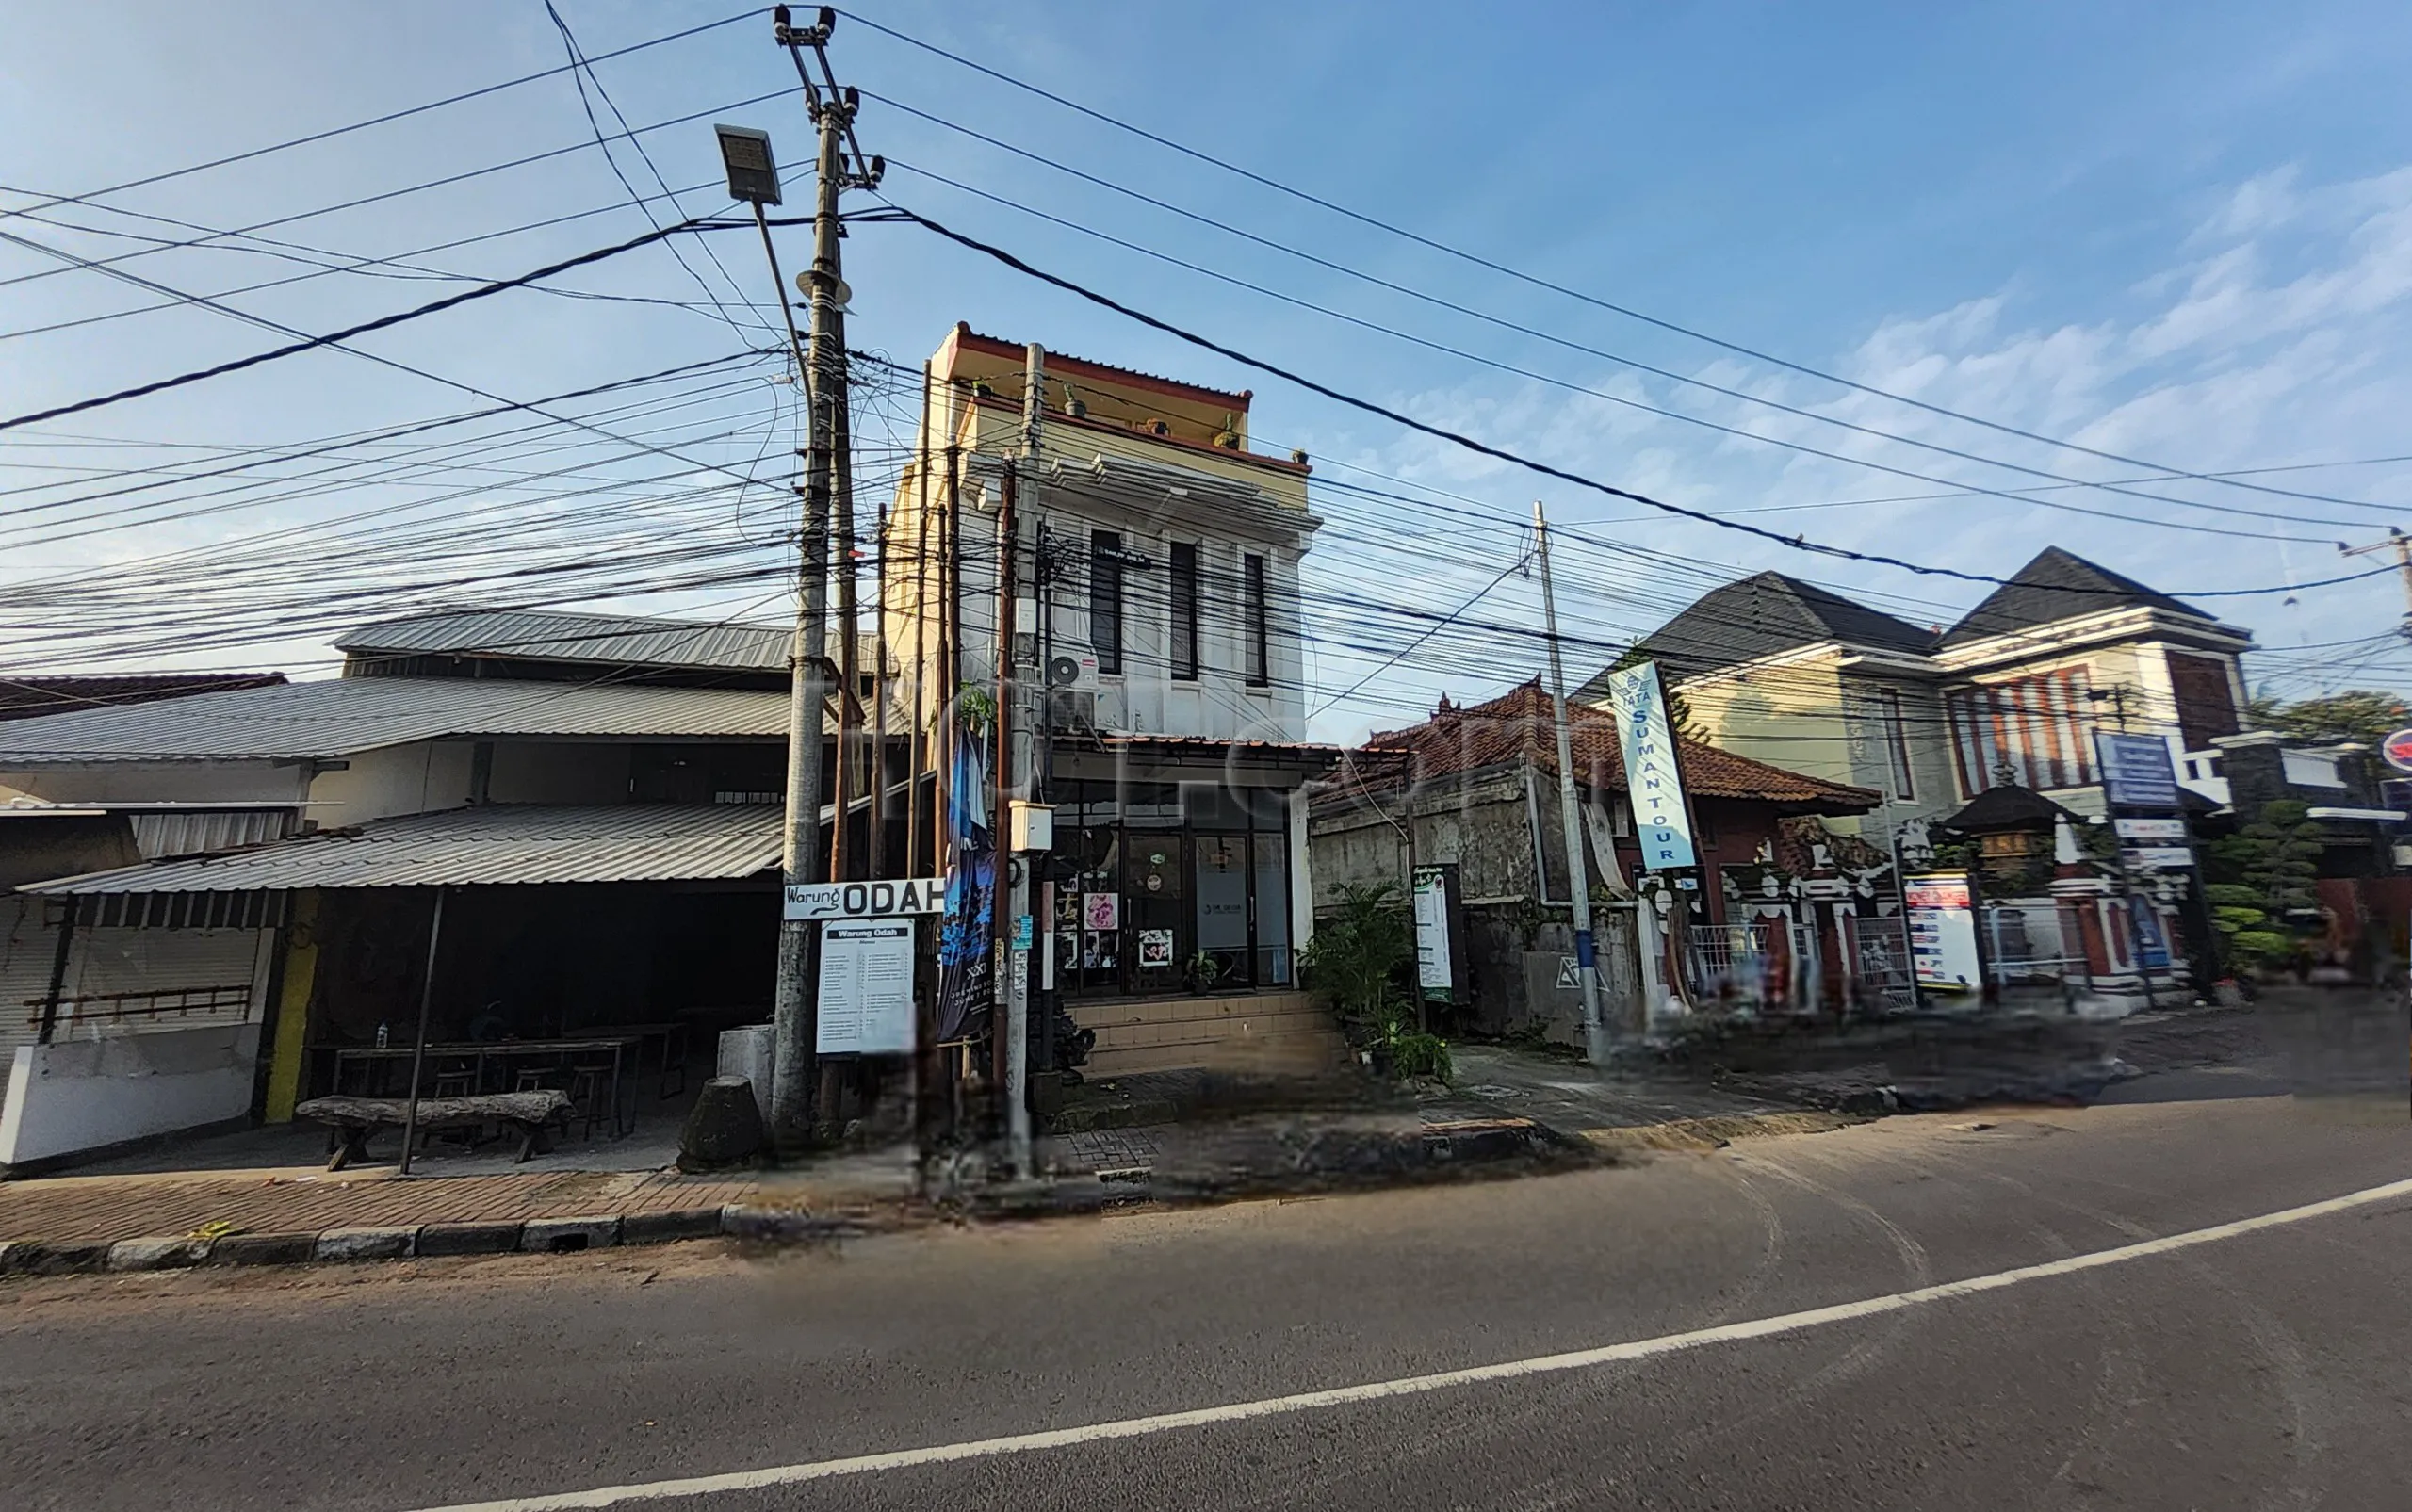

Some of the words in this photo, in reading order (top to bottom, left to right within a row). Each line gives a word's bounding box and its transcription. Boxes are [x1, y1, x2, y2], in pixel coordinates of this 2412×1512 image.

[787, 886, 840, 915] Warung
[838, 930, 872, 938] Warung
[873, 928, 898, 937] Odah
